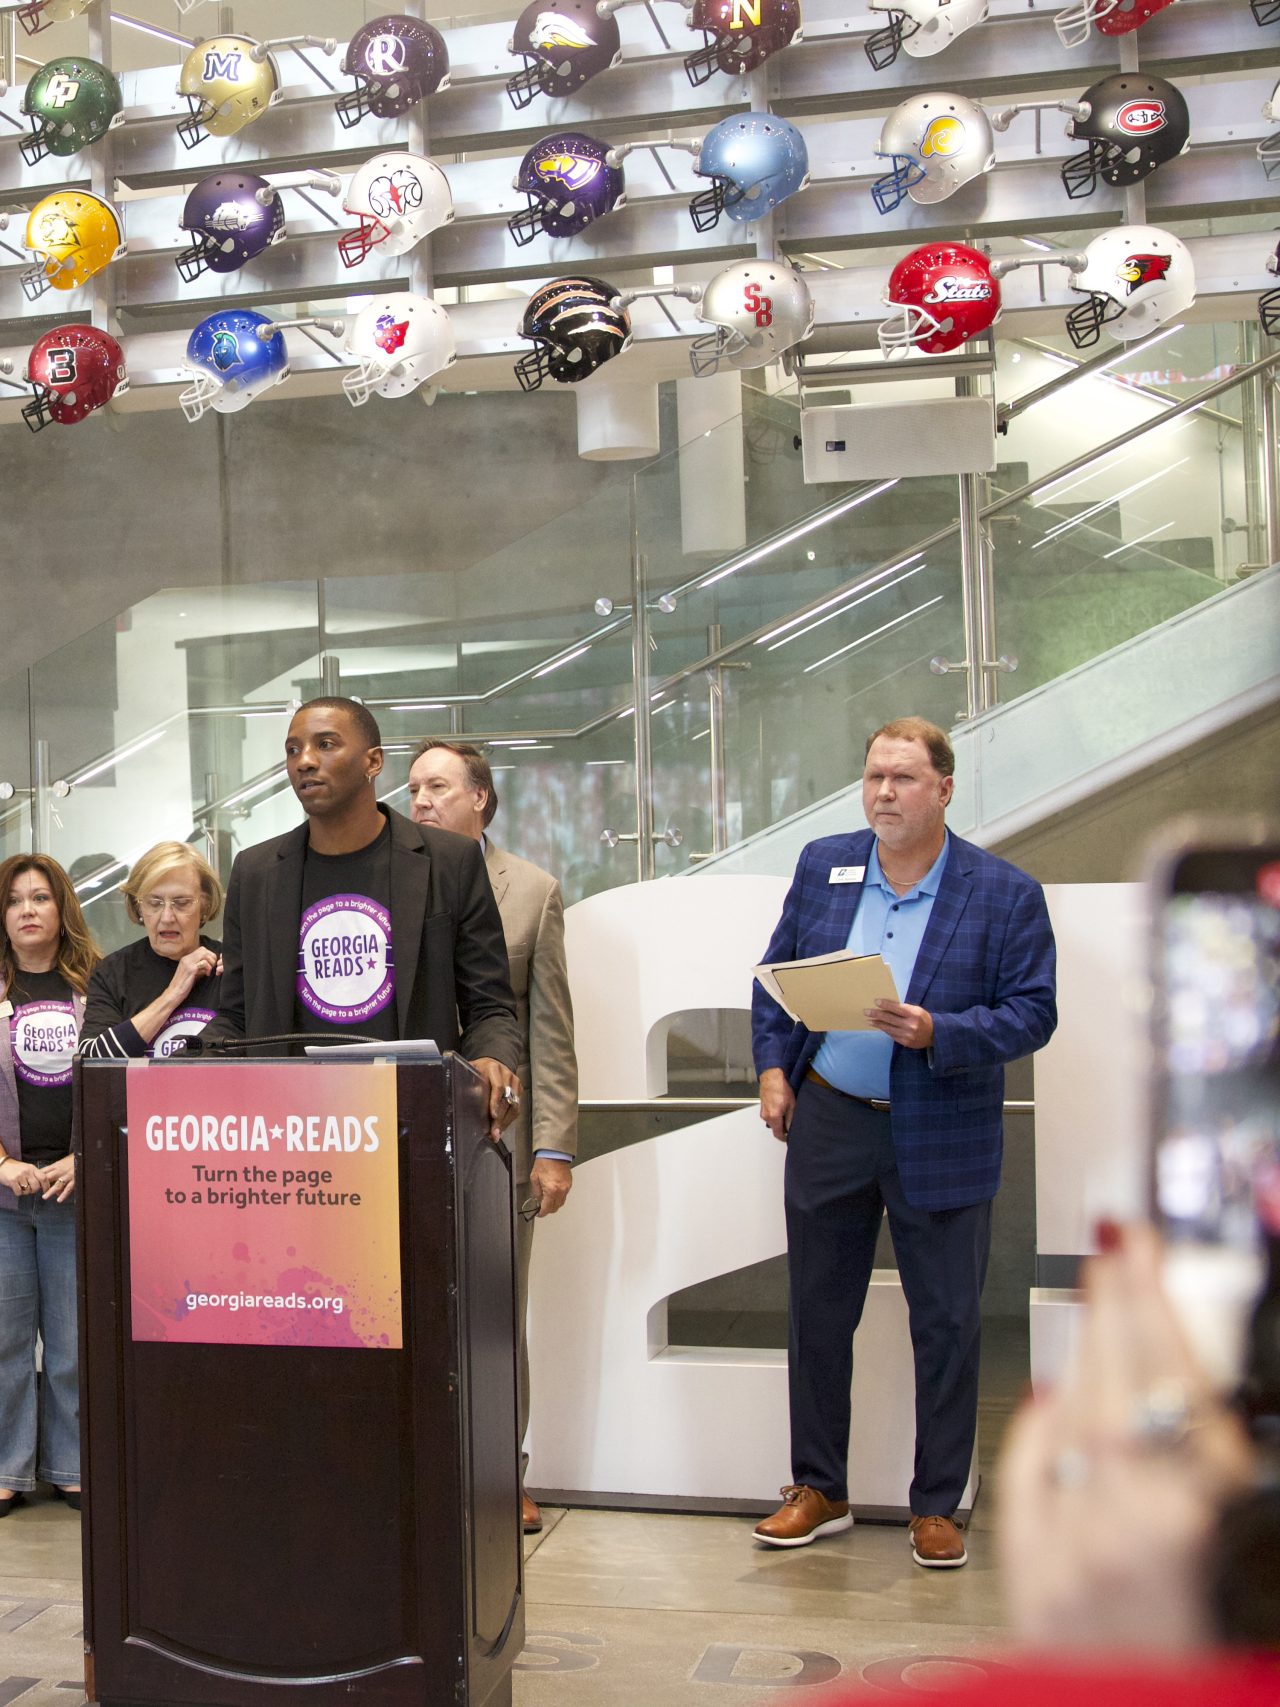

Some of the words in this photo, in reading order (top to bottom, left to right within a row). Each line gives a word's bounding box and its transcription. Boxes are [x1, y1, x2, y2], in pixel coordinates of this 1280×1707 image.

[202, 52, 241, 81] M
[370, 36, 409, 75] R
[47, 347, 77, 385] B
[306, 912, 318, 923] the
[318, 903, 334, 914] page
[351, 900, 377, 914] brighter
[311, 934, 379, 958] GEORGIA
[314, 957, 364, 979] READS
[301, 987, 313, 1002] Turn
[312, 1000, 321, 1010] the
[321, 1007, 337, 1017] page
[354, 1000, 378, 1016] brighter
[377, 982, 393, 1001] future
[23, 1023, 76, 1039] GEORGIA
[23, 1037, 64, 1052] READS
[145, 1115, 270, 1152] GEORGIA
[286, 1115, 380, 1153] READS
[192, 1165, 238, 1183] Turn
[242, 1165, 277, 1183] the
[282, 1170, 333, 1187] page
[165, 1188, 186, 1204] to
[191, 1191, 203, 1204] a
[207, 1186, 291, 1209] brighter
[295, 1188, 361, 1206] future
[185, 1291, 344, 1314] georgiareads.org
